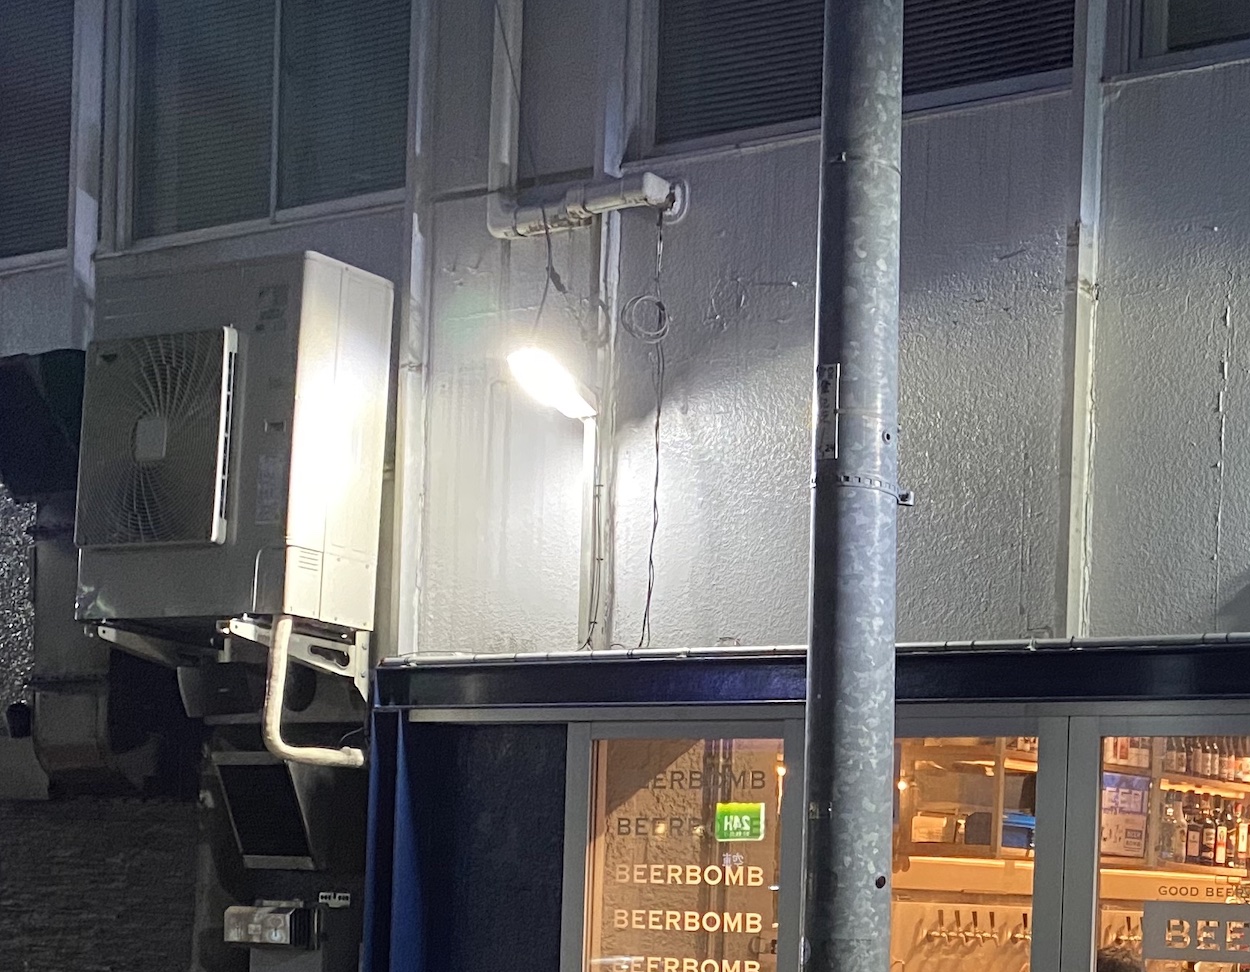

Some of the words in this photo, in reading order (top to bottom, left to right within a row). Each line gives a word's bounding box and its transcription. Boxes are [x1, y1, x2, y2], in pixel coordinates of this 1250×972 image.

[643, 771, 766, 789] ERBOMB
[615, 864, 764, 887] BEERBOMB
[1158, 886, 1199, 897] GOOD
[613, 909, 762, 933] BEERBOMB
